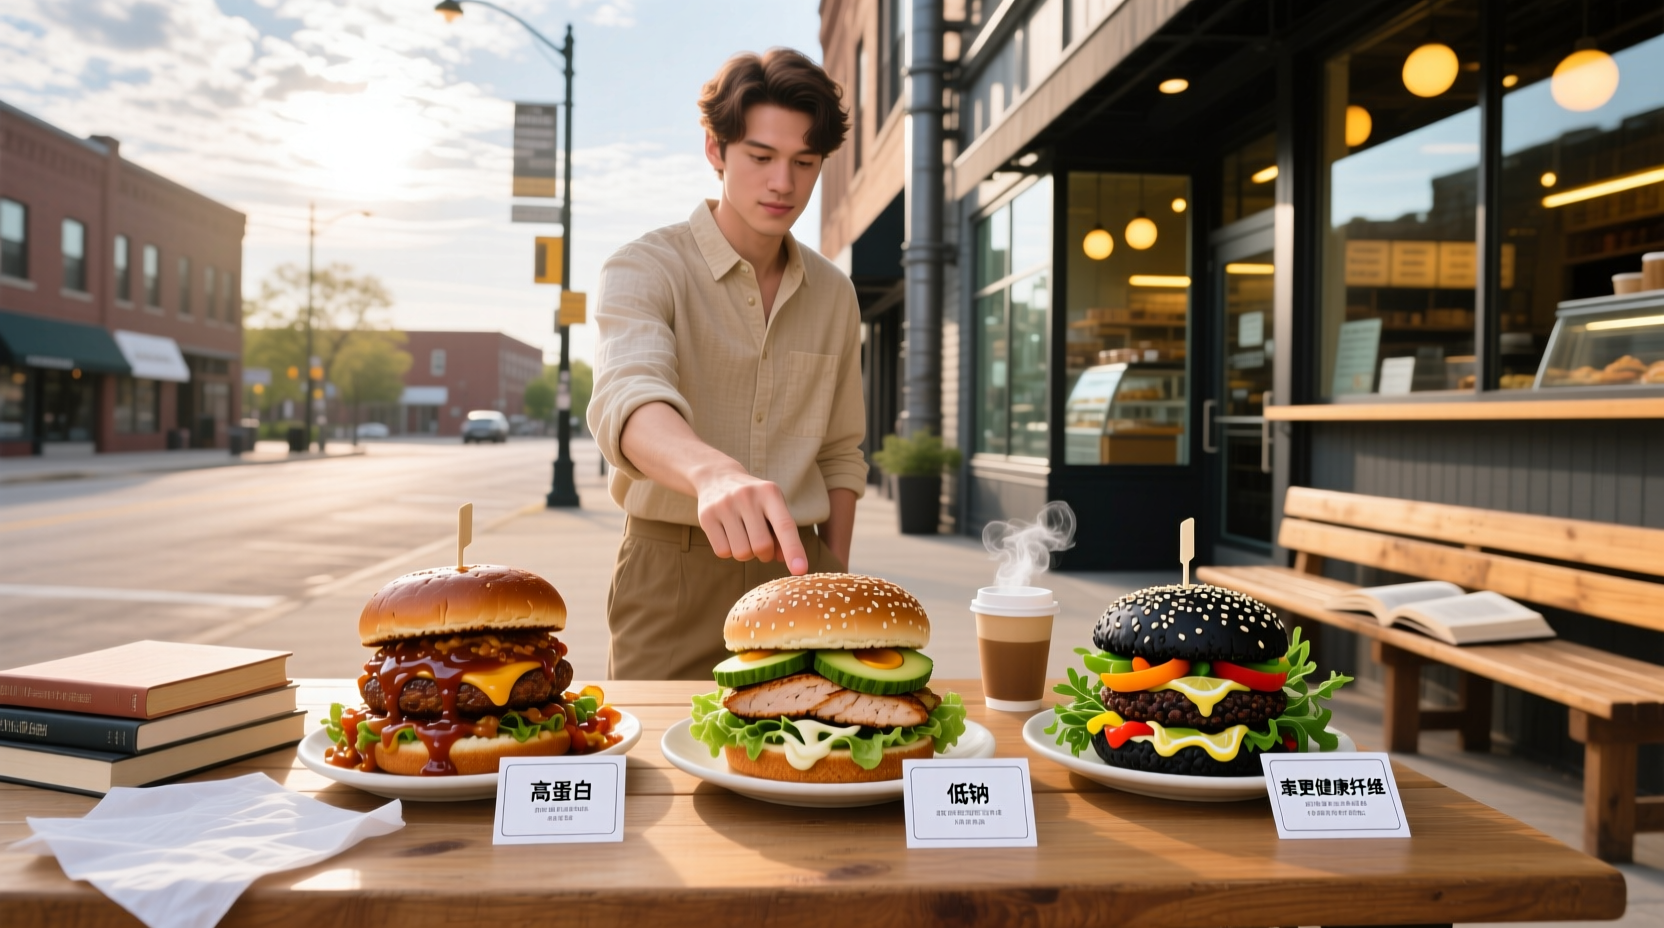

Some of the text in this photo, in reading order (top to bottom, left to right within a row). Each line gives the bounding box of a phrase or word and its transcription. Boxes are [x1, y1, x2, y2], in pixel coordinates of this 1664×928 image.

[530, 779, 592, 803] 高蛋白
[947, 782, 990, 805] 低钠
